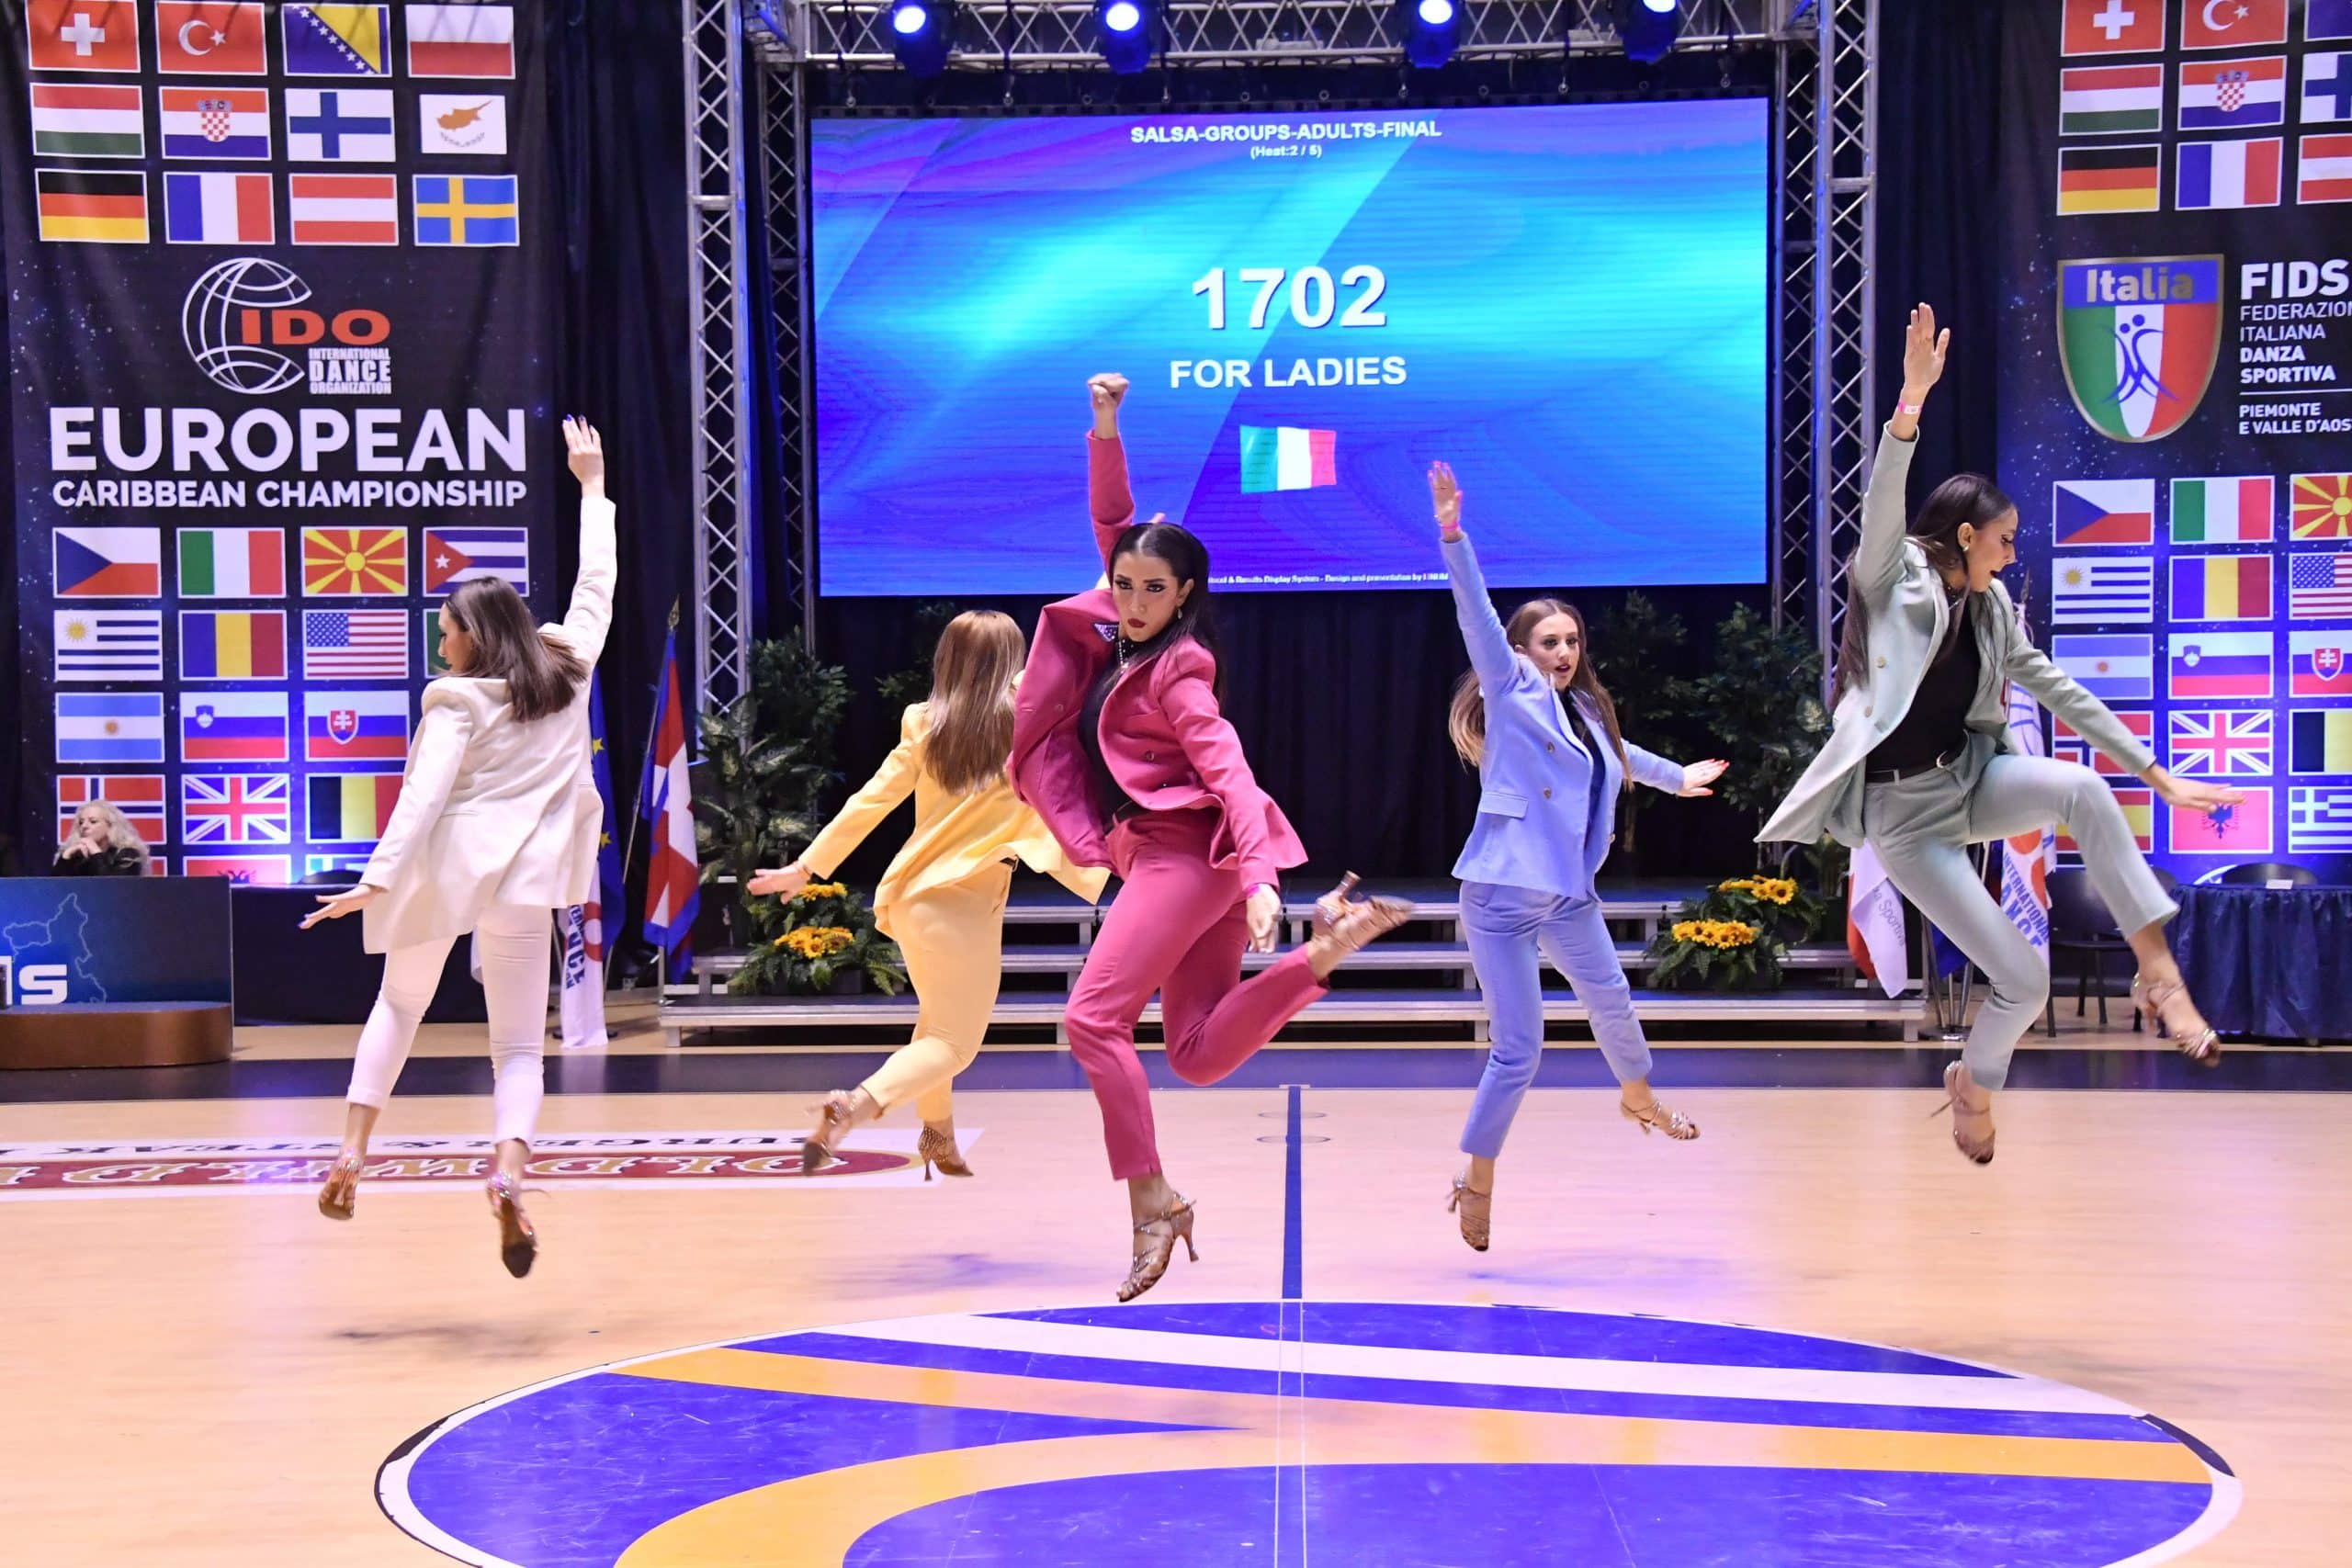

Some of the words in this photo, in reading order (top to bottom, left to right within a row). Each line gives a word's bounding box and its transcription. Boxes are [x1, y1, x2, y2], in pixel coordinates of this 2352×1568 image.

[1131, 120, 1442, 143] SALSA-GROUPS-ADULTS-FINAL
[2086, 267, 2194, 303] Italia
[2240, 259, 2349, 300] FIDS
[1193, 265, 1386, 330] 1702
[241, 309, 391, 345] IDO
[2239, 323, 2326, 343] ITALIANA
[308, 348, 391, 361] INTERNATIONAL
[2239, 345, 2306, 364] DANZA
[308, 359, 392, 383] DANCE
[1170, 359, 1252, 389] FOR
[1263, 356, 1407, 387] LADIES
[2239, 365, 2336, 384] SPORTIVA
[309, 381, 392, 395] ORGANIZATION
[2238, 402, 2322, 419] PIEMONTE
[2238, 421, 2250, 435] E
[2251, 419, 2302, 434] VALLE
[2305, 418, 2352, 433] D'AOS
[50, 407, 526, 472] EUROPEAN
[52, 479, 246, 508] CARIBBEAN
[255, 479, 527, 508] CHAMPIONSHIP
[463, 1137, 808, 1147] URGE
[525, 1155, 849, 1175] OLD
